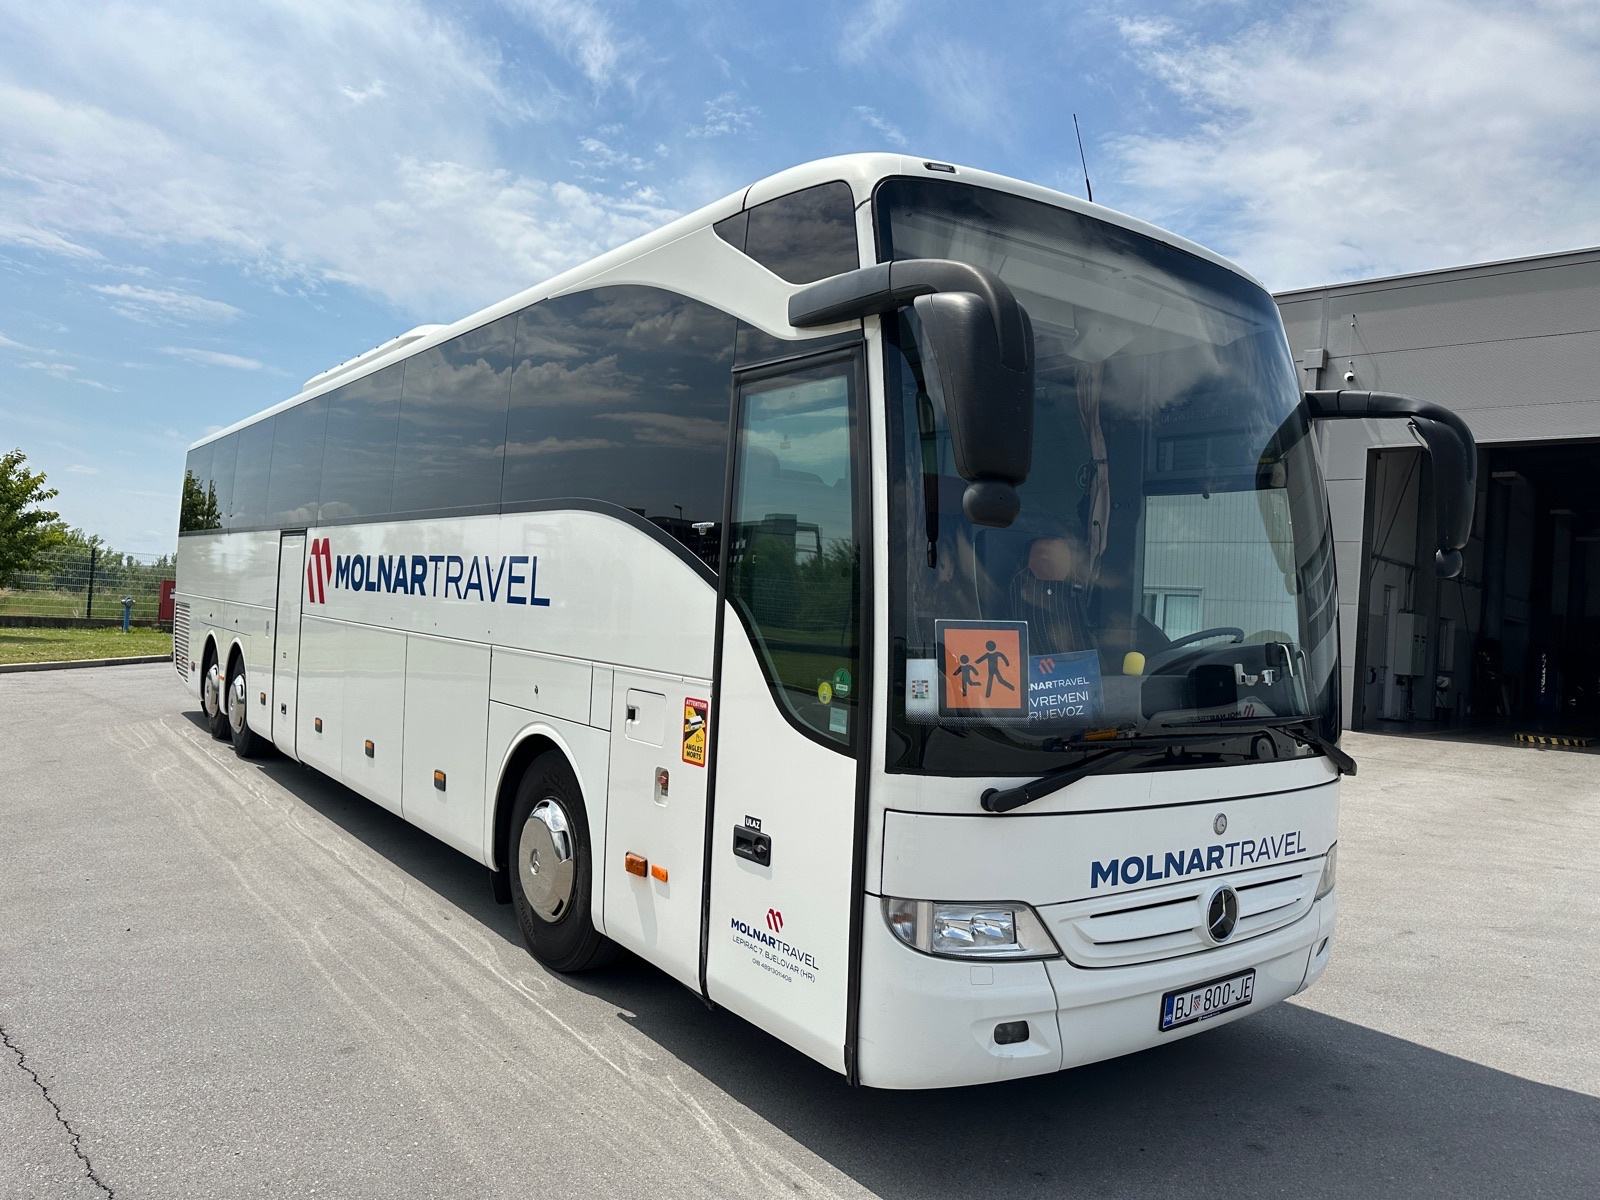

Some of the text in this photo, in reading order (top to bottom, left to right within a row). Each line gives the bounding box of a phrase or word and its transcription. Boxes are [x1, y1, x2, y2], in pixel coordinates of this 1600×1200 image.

[335, 554, 550, 607] MOLNARTRAVEL
[1028, 676, 1090, 691] NARTRAVEL
[1030, 690, 1089, 708] VREMENI
[686, 743, 703, 753] ANGLES
[686, 750, 702, 760] MORTS
[1090, 831, 1307, 888] MOLNARTRAVEL
[731, 917, 819, 971] MOLNARTRAVEL
[732, 935, 758, 953] LEPIRAC
[765, 951, 799, 975] BJELOVAR
[800, 968, 816, 983] (HR)
[1175, 994, 1194, 1020] BJ
[1203, 976, 1252, 1011] 800-JE
